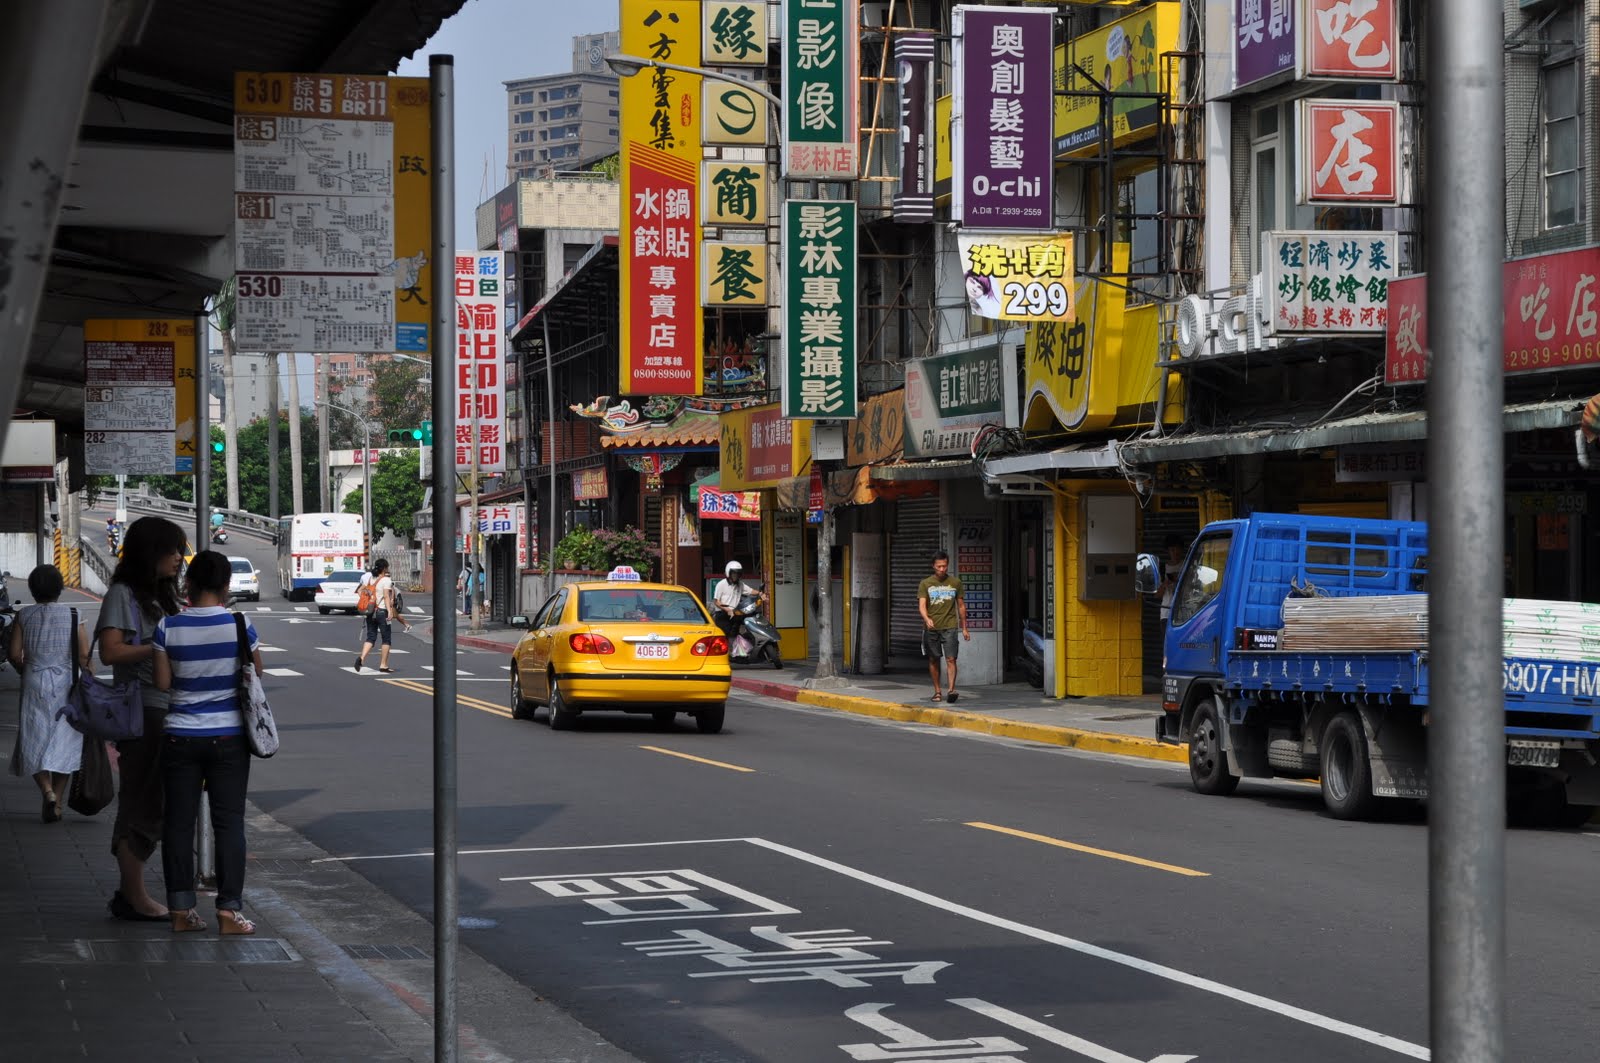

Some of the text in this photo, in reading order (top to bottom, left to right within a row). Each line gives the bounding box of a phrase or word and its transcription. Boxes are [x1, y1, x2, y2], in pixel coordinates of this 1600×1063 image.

[1239, 0, 1292, 49] 奧創
[643, 9, 680, 150] 八方雲集
[796, 0, 838, 130] 影像
[1278, 53, 1292, 67] Hair
[245, 78, 282, 102] 530
[293, 97, 333, 113] BR 5
[989, 23, 1025, 170] 奧創髮藝
[790, 146, 852, 173] 影林店
[634, 187, 661, 257] 水餃
[665, 188, 690, 258] 鍋貼
[968, 243, 1066, 279] 洗+剪
[1279, 240, 1391, 272] 經濟炒菜
[238, 276, 281, 298] 530
[455, 256, 475, 297] 黑白
[479, 257, 499, 297] 彩色
[1278, 273, 1387, 304] 炒飯燴飯
[649, 265, 677, 348] 專賣店
[799, 206, 845, 413] 影林專業攝影
[1003, 281, 1068, 316] 299
[1177, 272, 1278, 358] O-ch
[148, 322, 168, 337] 282
[1394, 303, 1424, 358] 敏
[457, 303, 498, 420] 輸出印刷
[633, 367, 692, 379] 0800-898000
[644, 355, 683, 366] 加盟專線
[86, 432, 106, 444] 282
[455, 425, 474, 465] 裝訂
[479, 425, 500, 465] 影印
